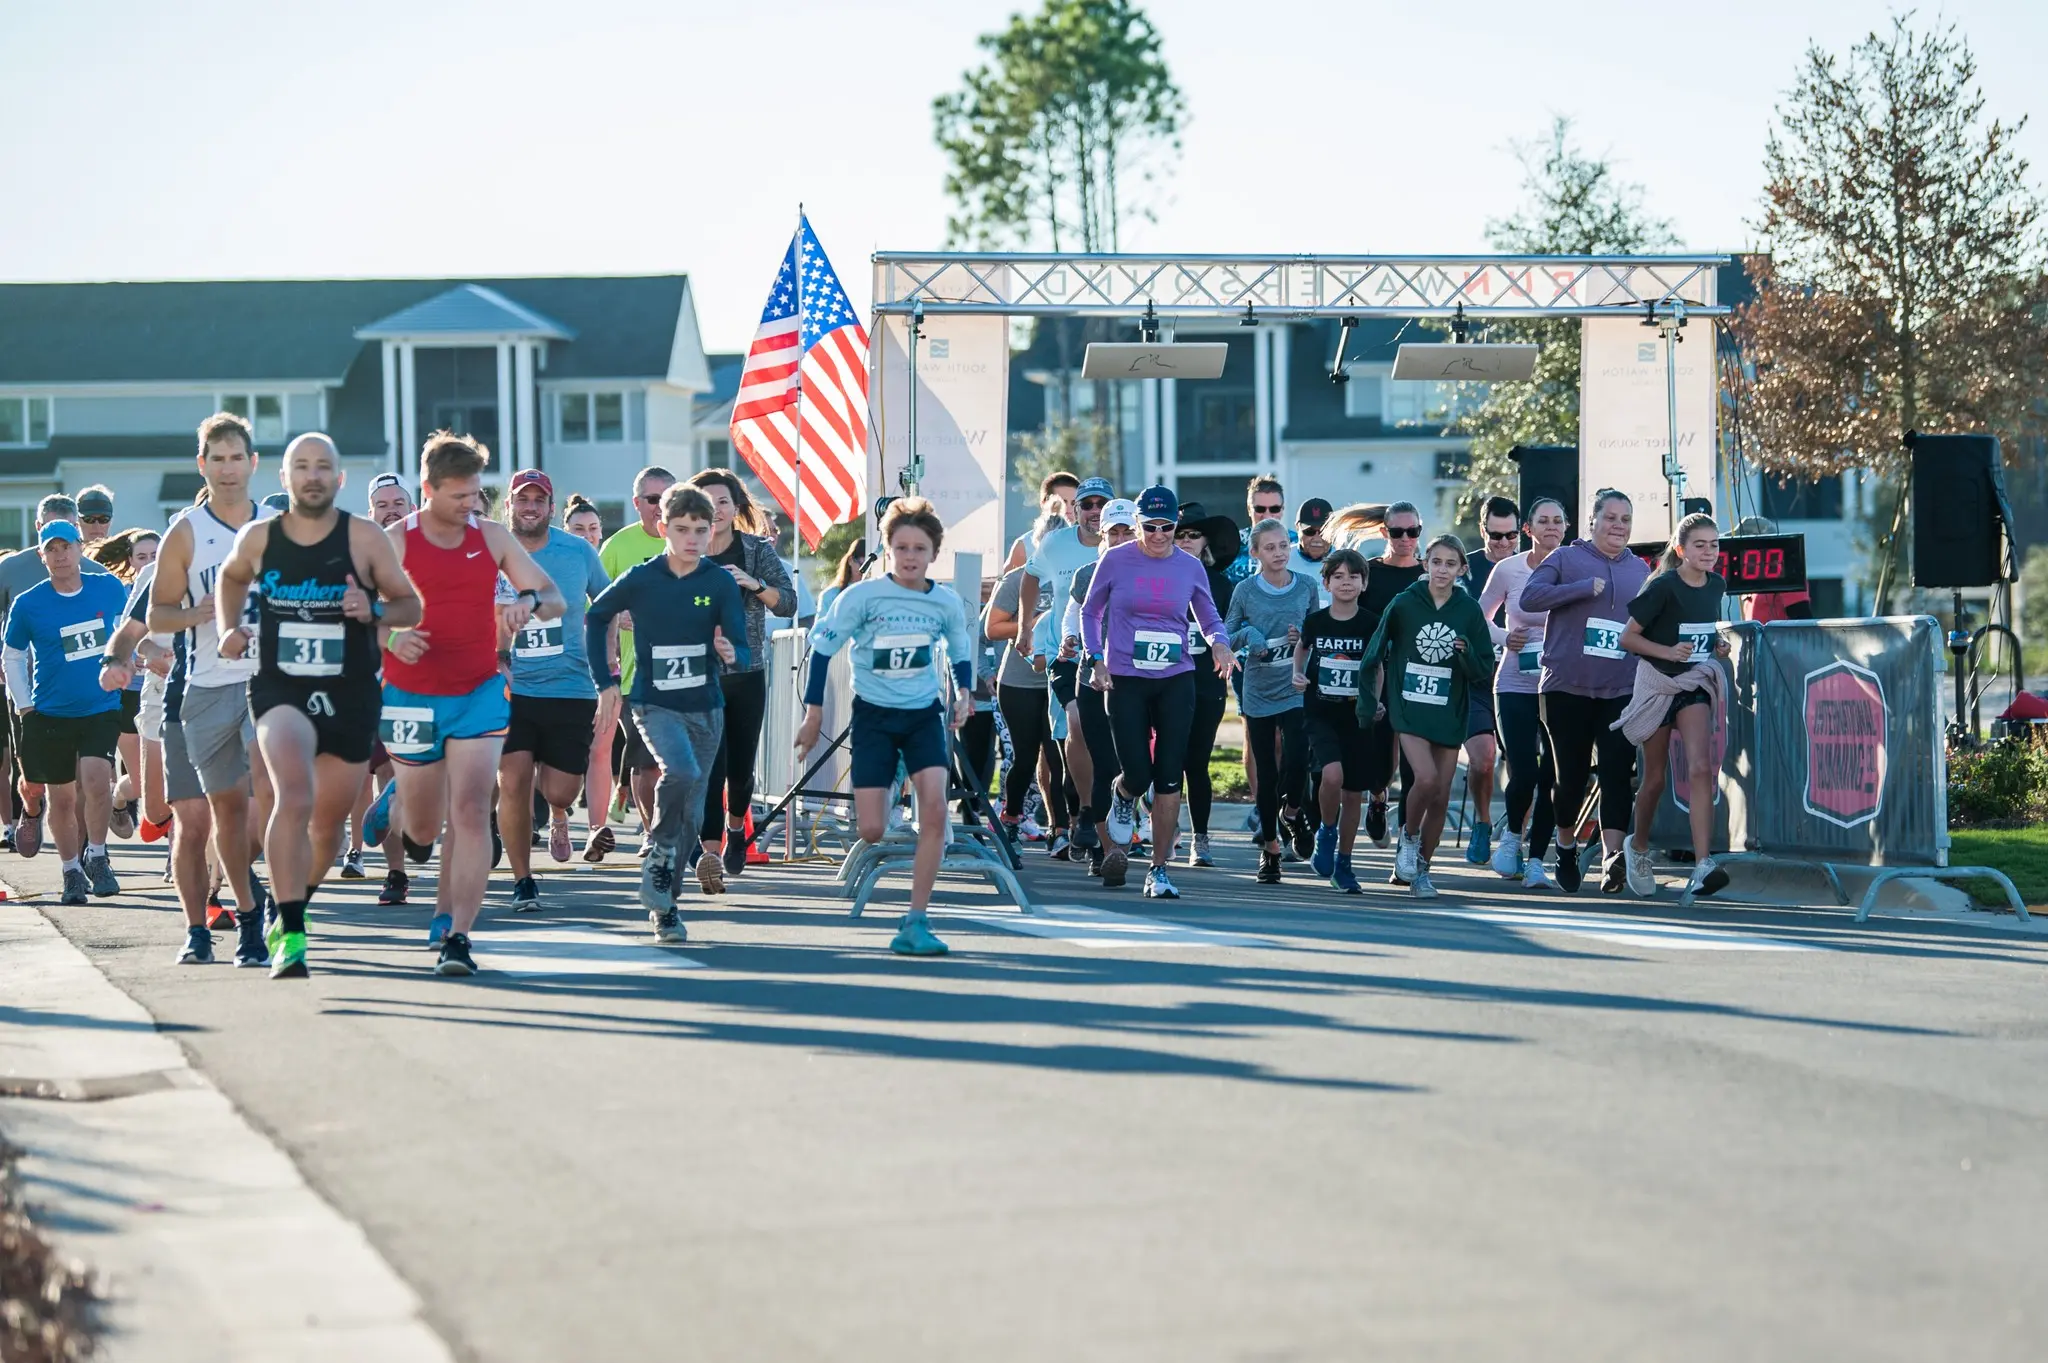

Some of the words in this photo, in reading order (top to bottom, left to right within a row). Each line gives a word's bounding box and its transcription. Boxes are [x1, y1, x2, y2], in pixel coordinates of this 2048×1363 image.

[302, 600, 344, 609] COMPAN
[74, 631, 97, 651] 13
[526, 628, 550, 648] 51
[1316, 637, 1363, 650] EARTH
[1596, 629, 1619, 649] 33
[1691, 634, 1709, 653] 32
[294, 638, 325, 664] 31
[889, 646, 917, 670] 67
[1146, 642, 1170, 662] 62
[1272, 644, 1291, 662] 27
[666, 657, 693, 679] 21
[1330, 669, 1352, 687] 34
[1415, 675, 1439, 695] 35
[392, 720, 419, 744] 82
